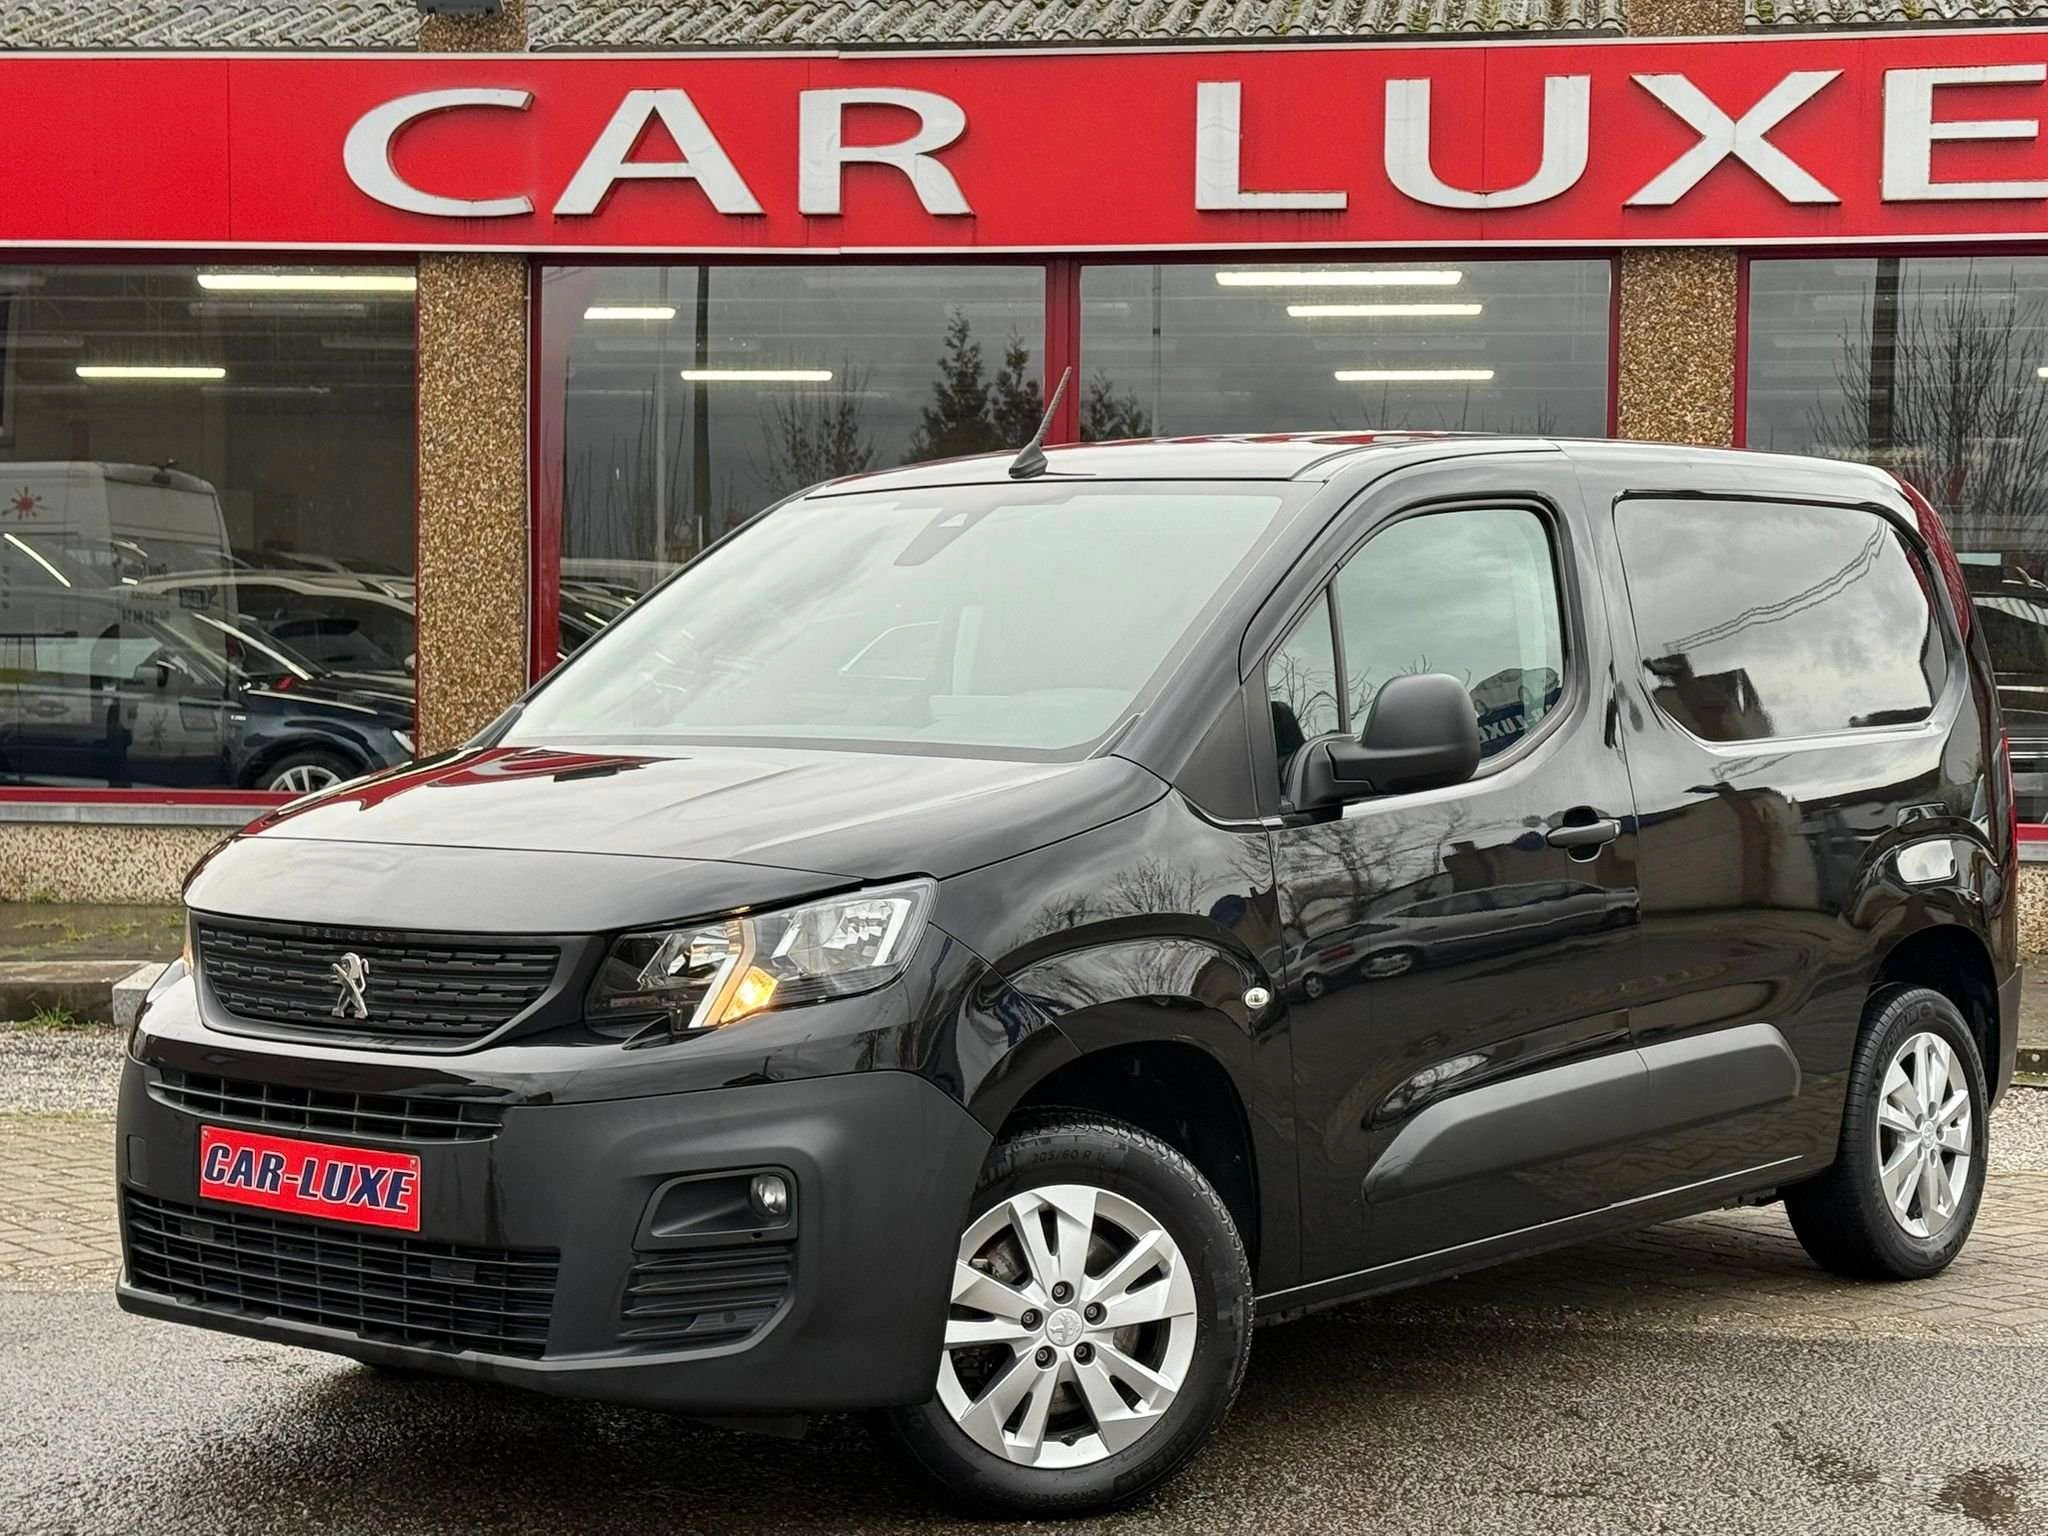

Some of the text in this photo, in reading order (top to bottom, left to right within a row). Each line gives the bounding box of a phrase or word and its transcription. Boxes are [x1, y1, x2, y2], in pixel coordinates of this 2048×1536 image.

[343, 63, 2048, 217] CAR LUXE
[203, 1142, 417, 1213] CAR-LUXE
